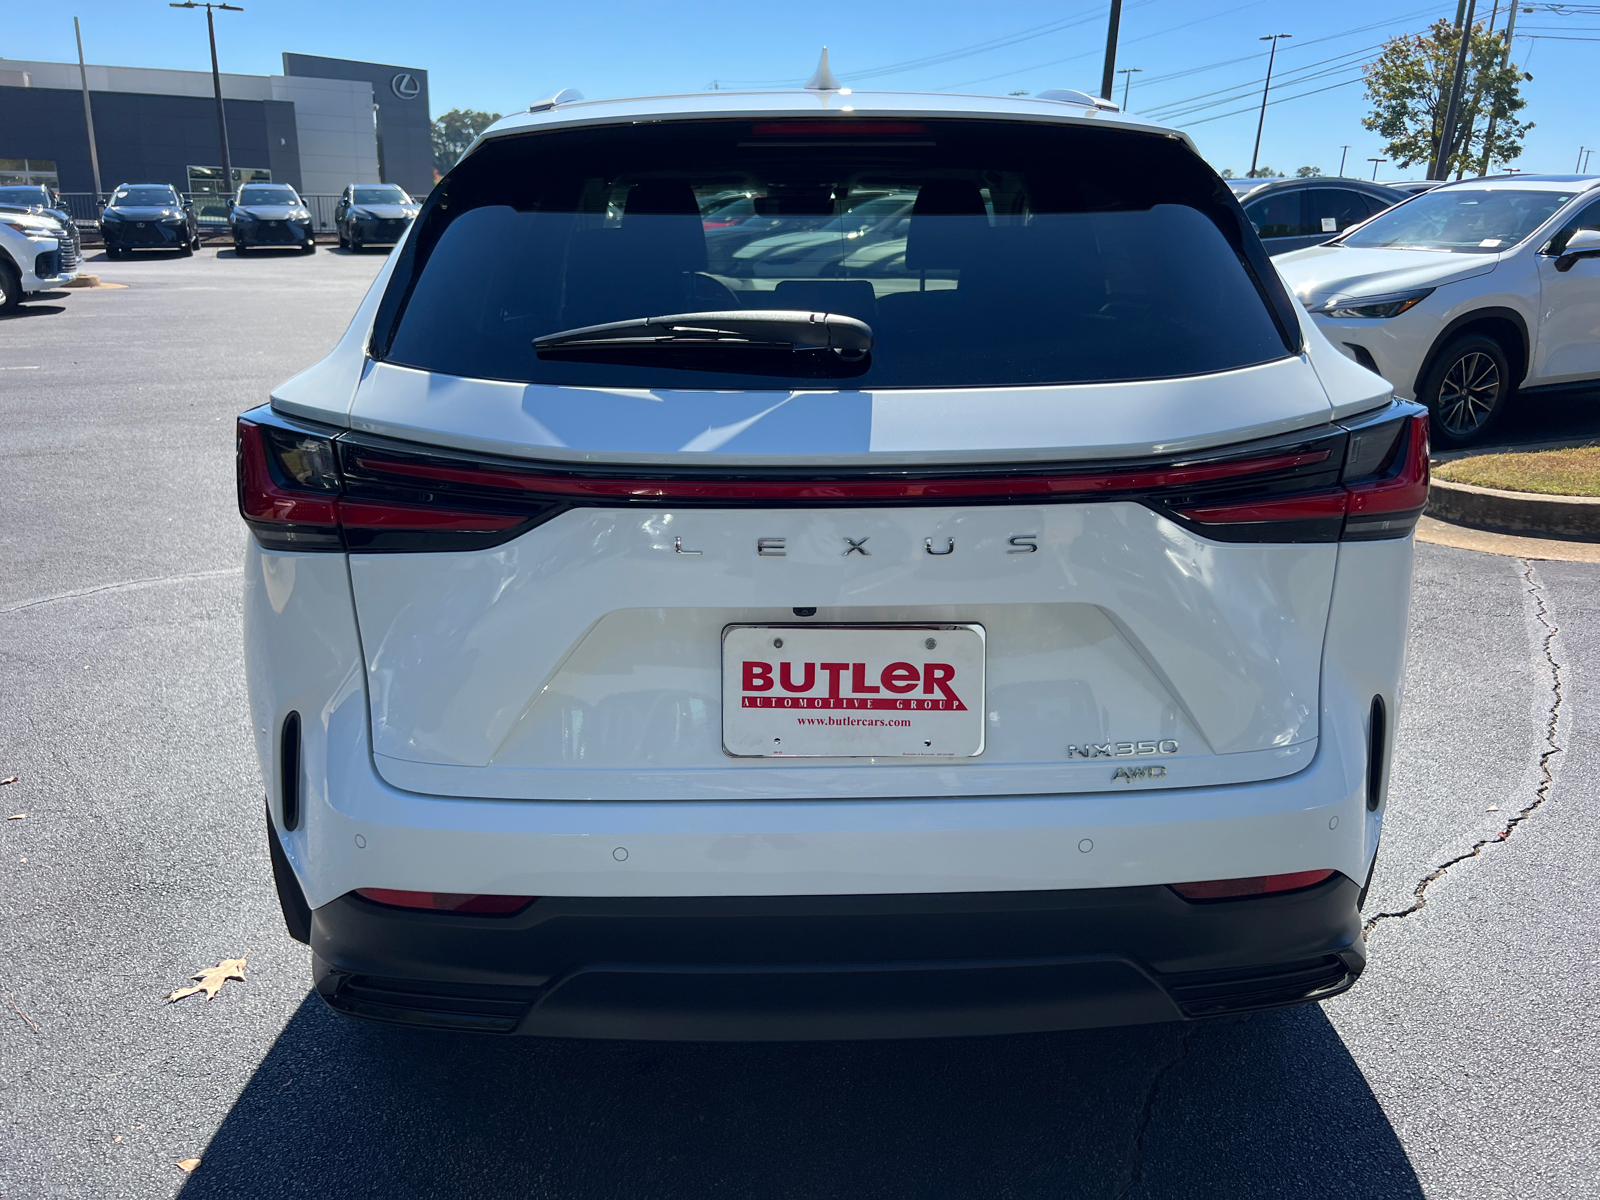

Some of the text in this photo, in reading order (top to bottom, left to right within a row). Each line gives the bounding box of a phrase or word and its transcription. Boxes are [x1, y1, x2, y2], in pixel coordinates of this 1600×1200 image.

[674, 535, 1039, 556] LEXUS
[743, 697, 960, 710] AUTOMOTIVE GROUP
[797, 716, 911, 727] www.butlercars.com
[1068, 739, 1179, 759] NX350
[1110, 766, 1167, 784] AWD
